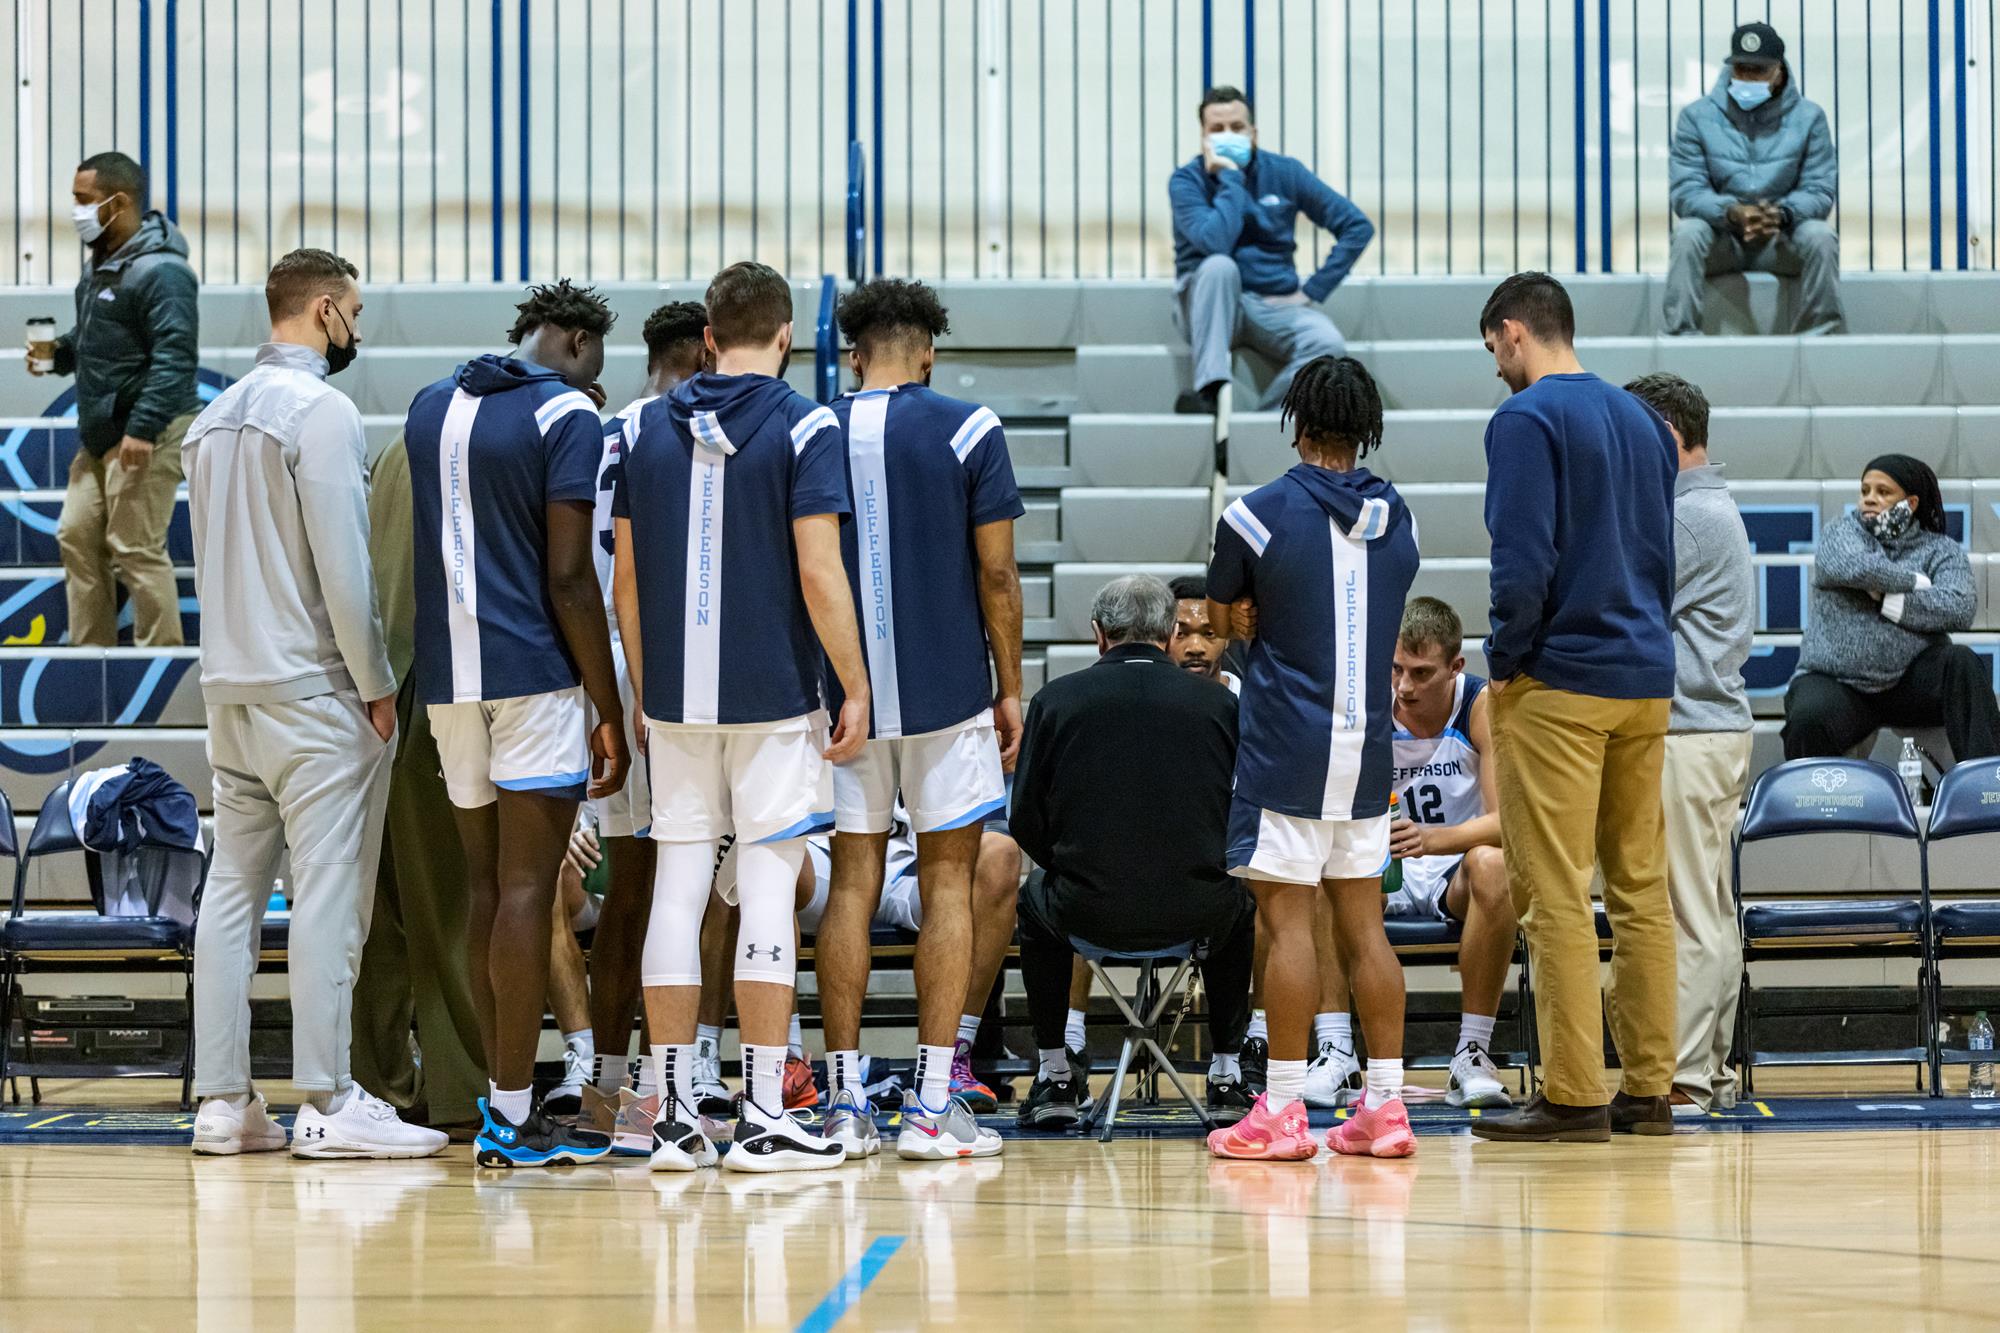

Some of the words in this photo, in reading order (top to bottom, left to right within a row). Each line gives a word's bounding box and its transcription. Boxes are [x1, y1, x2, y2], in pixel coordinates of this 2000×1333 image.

[450, 442, 465, 604] JEFFERSON
[696, 463, 714, 625] JEFFERSON
[864, 480, 887, 640] JEFFERSON
[1343, 570, 1356, 729] JEFFERSON
[1403, 784, 1445, 823] 12
